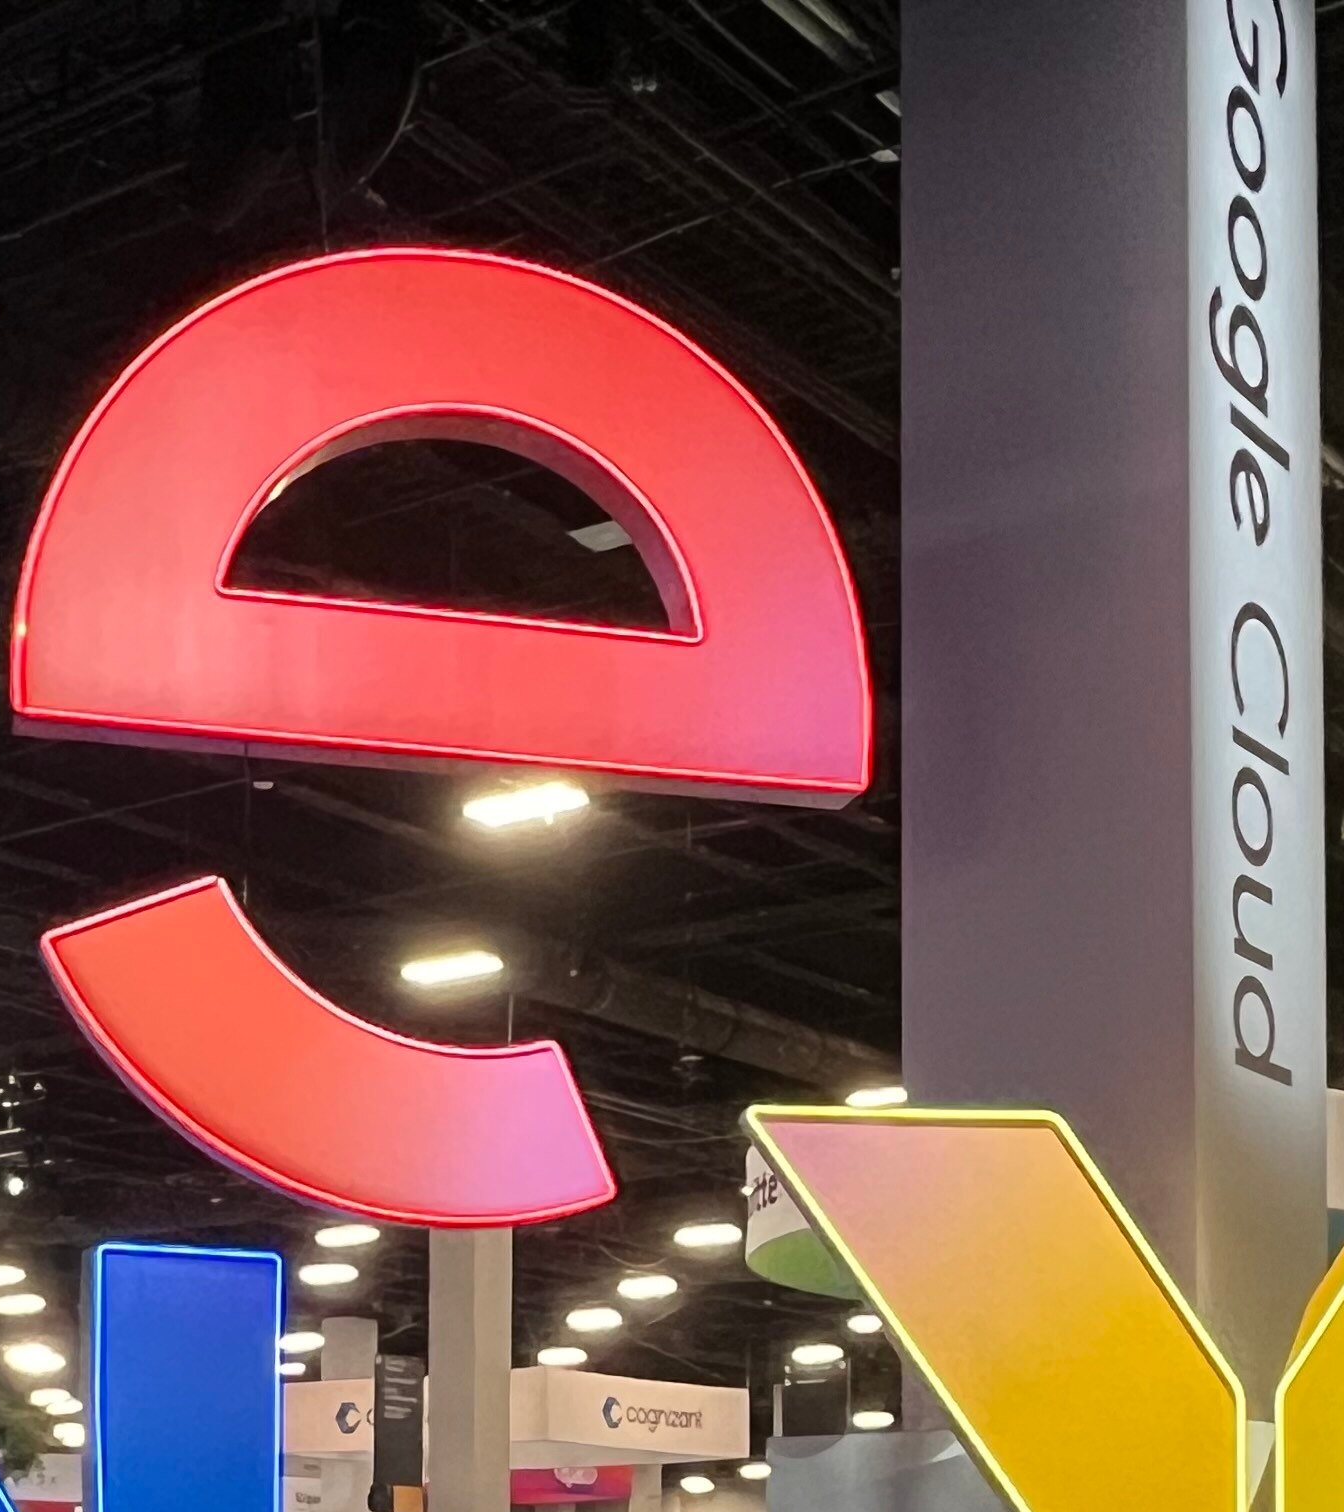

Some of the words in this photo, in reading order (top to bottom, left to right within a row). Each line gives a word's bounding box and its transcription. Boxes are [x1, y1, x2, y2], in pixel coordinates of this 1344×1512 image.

[1209, 0, 1291, 547] Google
[1231, 602, 1293, 1087] Cloud
[626, 1405, 703, 1433] cognizant
